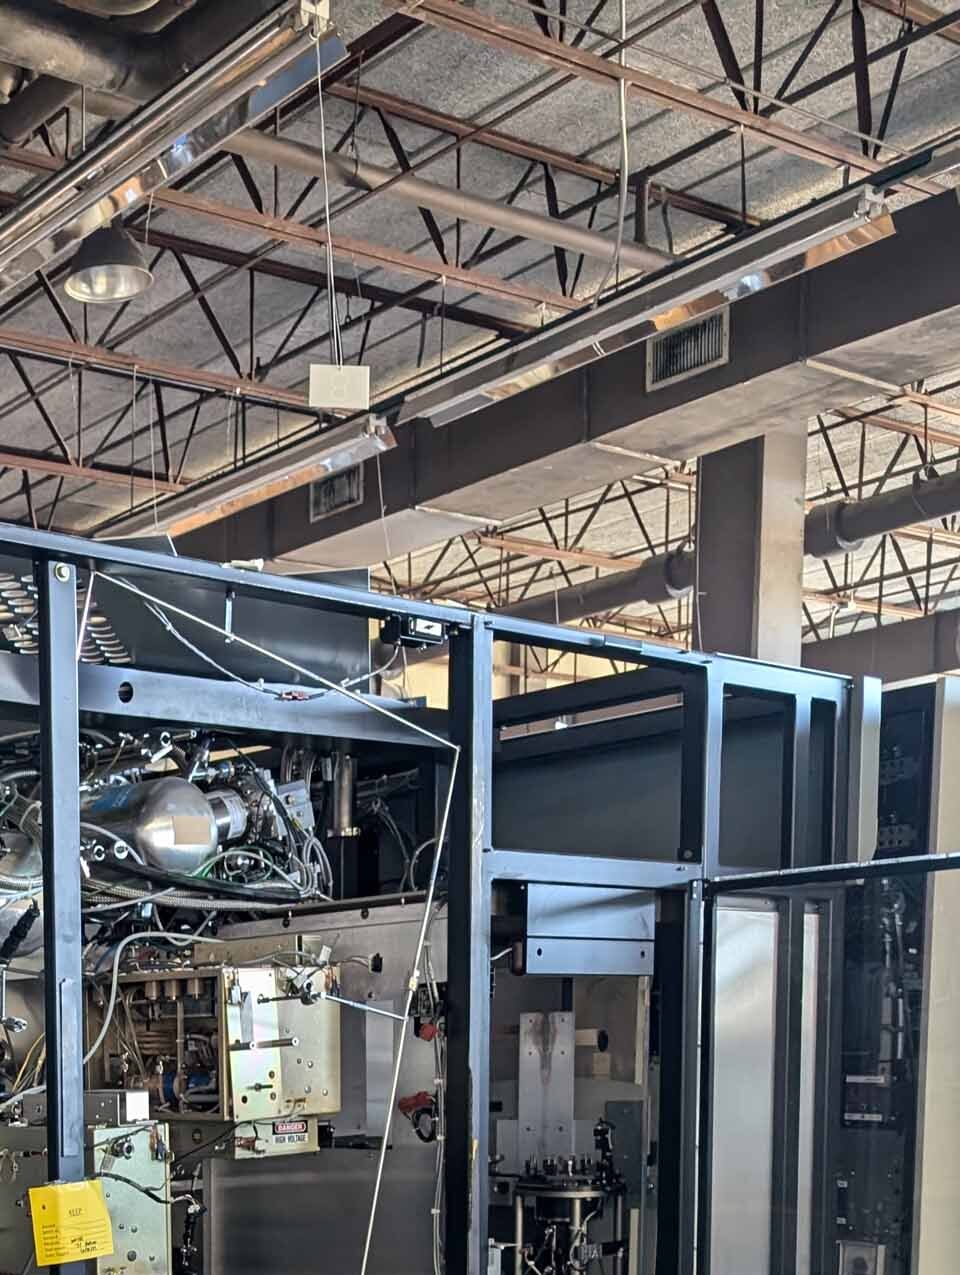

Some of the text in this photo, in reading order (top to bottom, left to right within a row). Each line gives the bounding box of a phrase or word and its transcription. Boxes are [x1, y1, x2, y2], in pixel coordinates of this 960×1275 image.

[279, 1122, 303, 1131] DANGER
[275, 1134, 306, 1143] HIGH VOLTAGE
